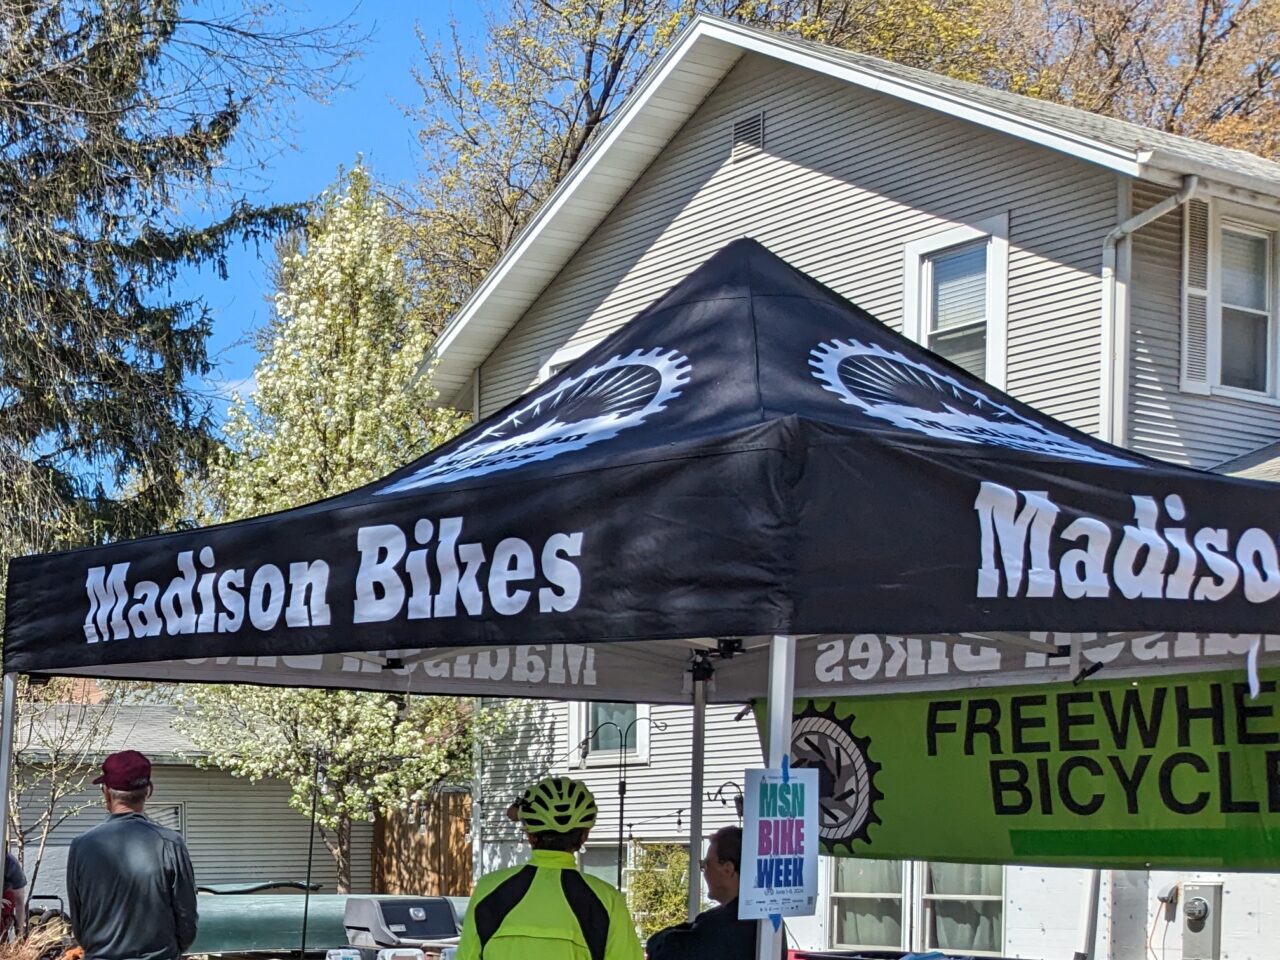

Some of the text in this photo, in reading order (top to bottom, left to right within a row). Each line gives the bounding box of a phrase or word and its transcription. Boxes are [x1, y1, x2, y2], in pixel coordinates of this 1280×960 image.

[974, 481, 1280, 603] Madiso
[83, 516, 585, 644] Madison Bikes
[927, 681, 1280, 756] FREEWHE
[759, 783, 805, 818] MSN
[757, 819, 805, 856] BIKE
[756, 857, 804, 889] WEEK
